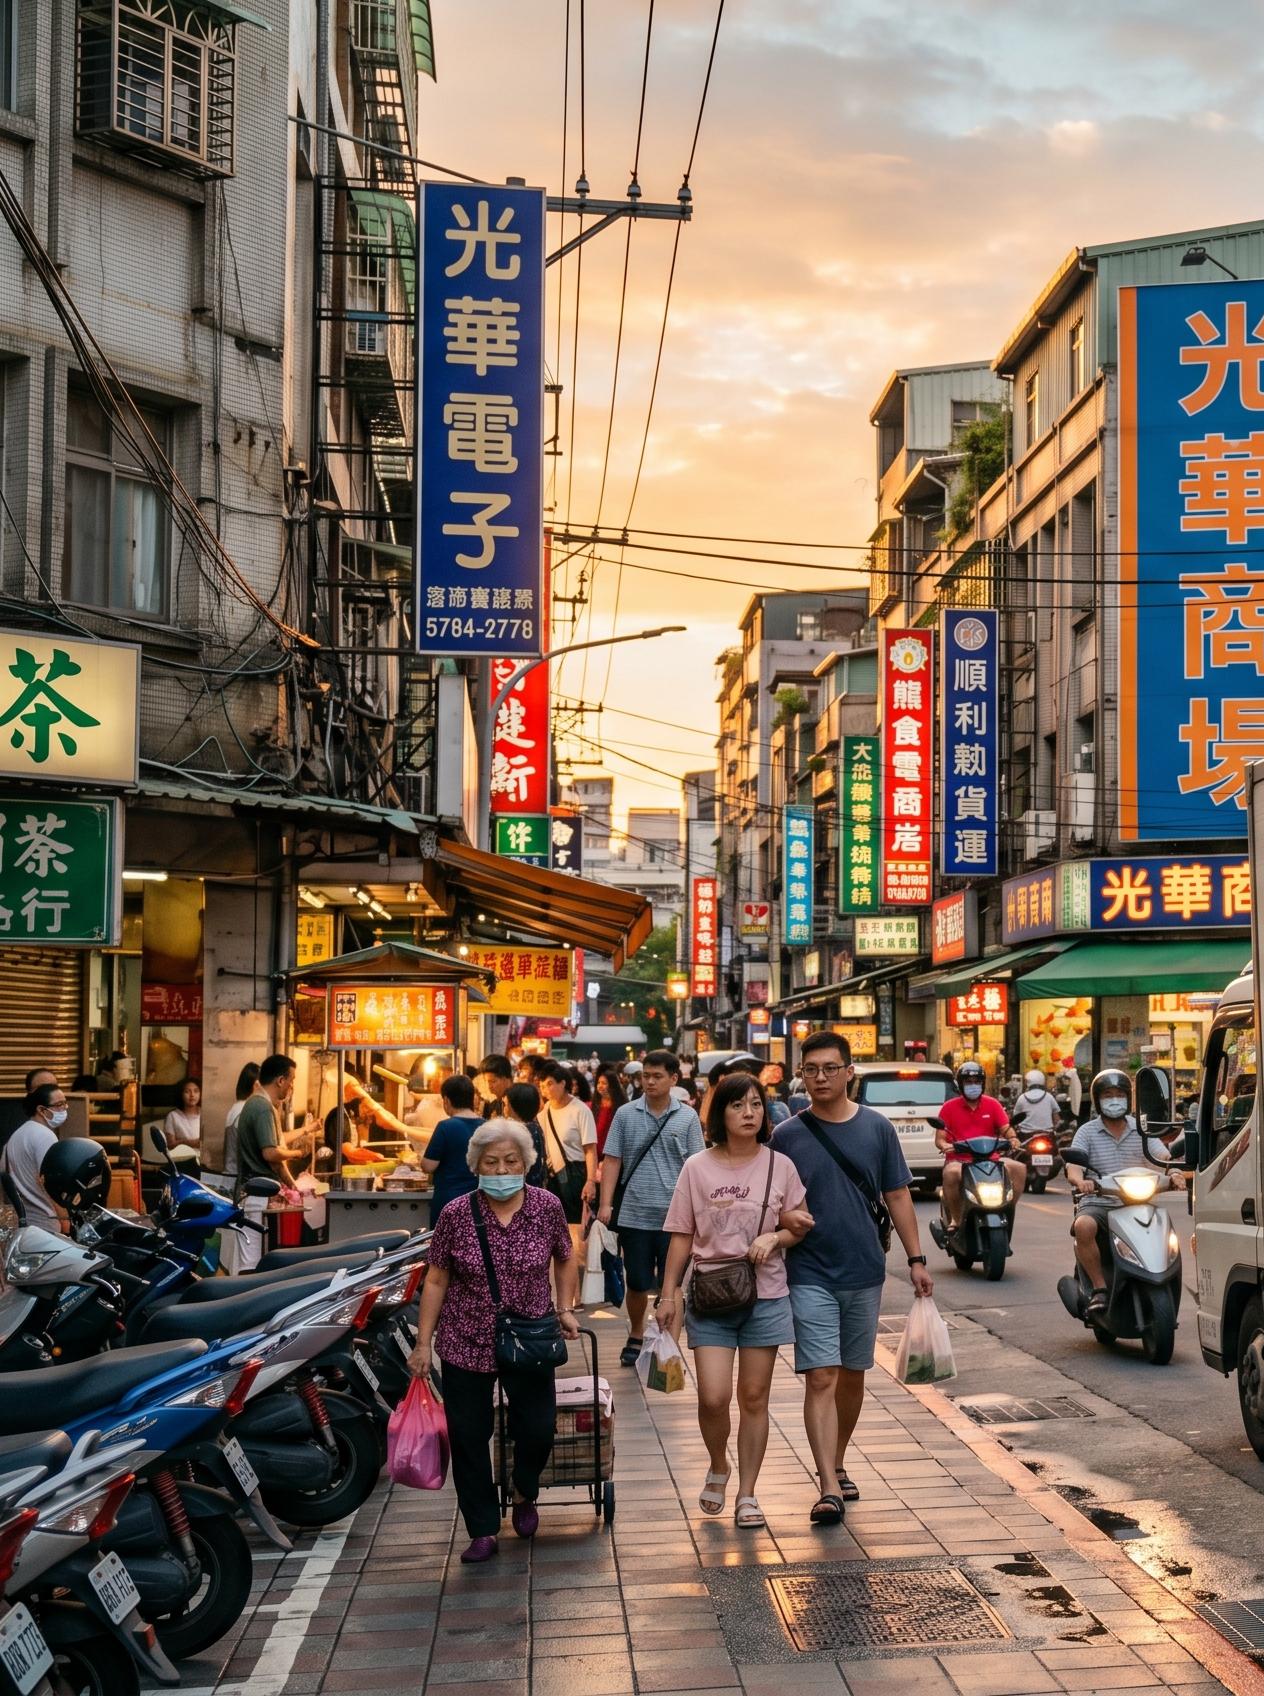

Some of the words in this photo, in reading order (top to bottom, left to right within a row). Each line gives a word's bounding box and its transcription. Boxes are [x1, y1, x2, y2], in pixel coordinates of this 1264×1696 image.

[442, 200, 522, 569] 光華電子
[426, 617, 533, 639] 5784-2778
[0, 647, 101, 763] 茶
[0, 812, 74, 878] 茶
